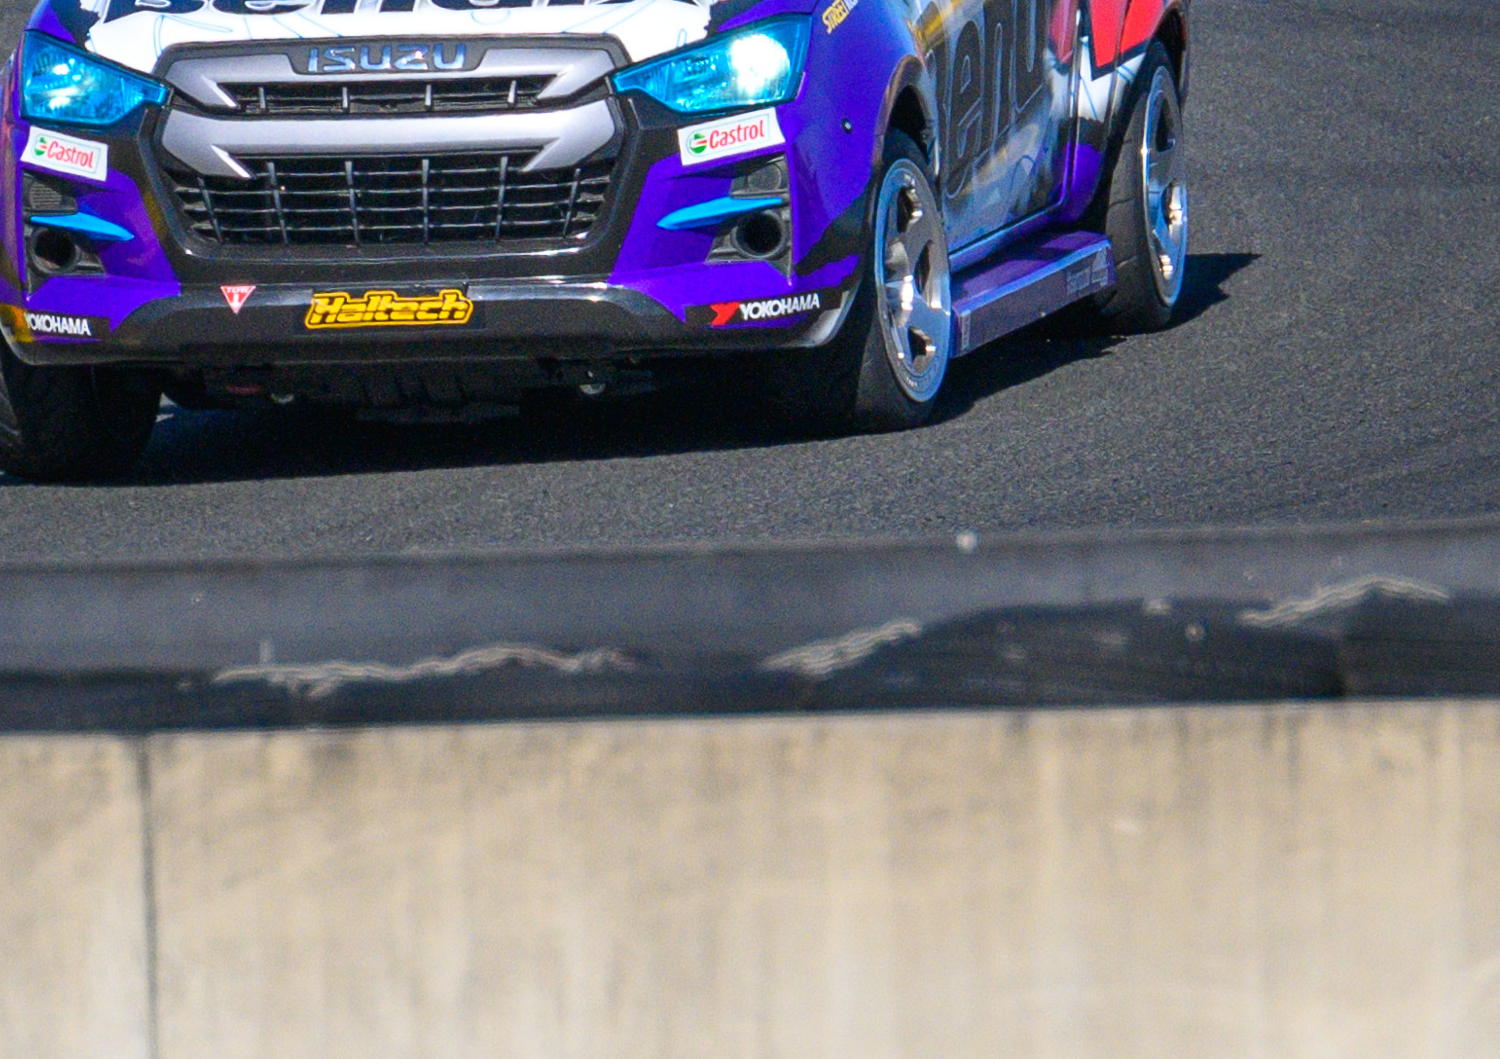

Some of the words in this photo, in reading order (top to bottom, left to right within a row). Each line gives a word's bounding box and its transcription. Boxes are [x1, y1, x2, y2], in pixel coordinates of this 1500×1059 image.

[307, 43, 467, 72] ISUZU
[709, 119, 765, 149] Castrol
[46, 140, 95, 169] Castrol
[306, 291, 472, 327] Haltech
[739, 293, 820, 321] YOKOHAMA
[23, 311, 92, 337] YOKOHAMA
